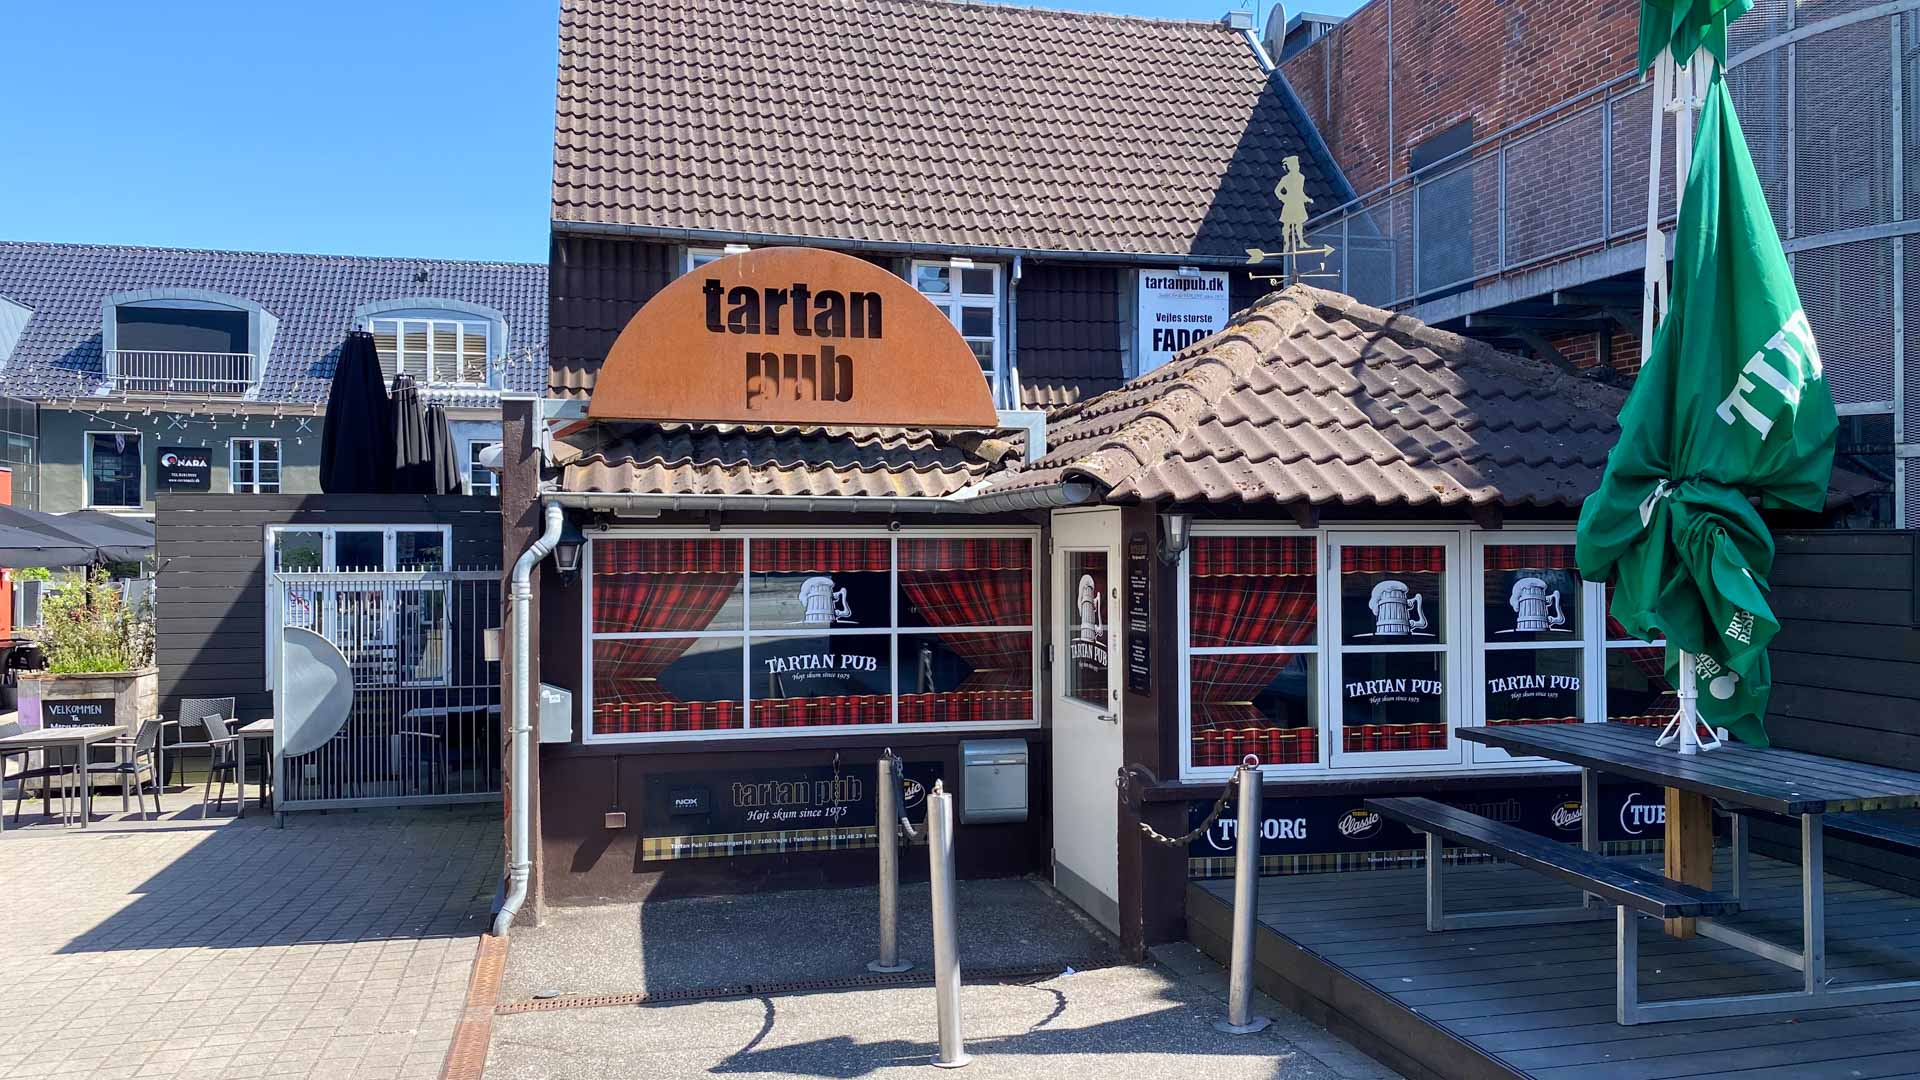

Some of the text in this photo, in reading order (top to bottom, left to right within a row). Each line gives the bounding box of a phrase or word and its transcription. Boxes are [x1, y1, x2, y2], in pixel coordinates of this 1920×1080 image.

[1145, 276, 1224, 291] tartanpub.dk
[703, 279, 882, 339] tartan
[1156, 313, 1183, 323] Vejles
[746, 345, 854, 410] pub
[177, 459, 208, 467] NARA
[764, 653, 877, 675] TARTAN PUB
[1071, 643, 1093, 659] TARTAN
[1094, 646, 1108, 666] PUB
[1345, 678, 1442, 698] TARTAN PUB
[1488, 674, 1580, 693] TARTAN PUB
[49, 704, 102, 715] VELKOMMEN
[732, 776, 863, 807] tartan pub
[675, 798, 698, 806] NOX
[747, 806, 848, 823] Højt skum since 1975
[1338, 812, 1379, 835] Classic
